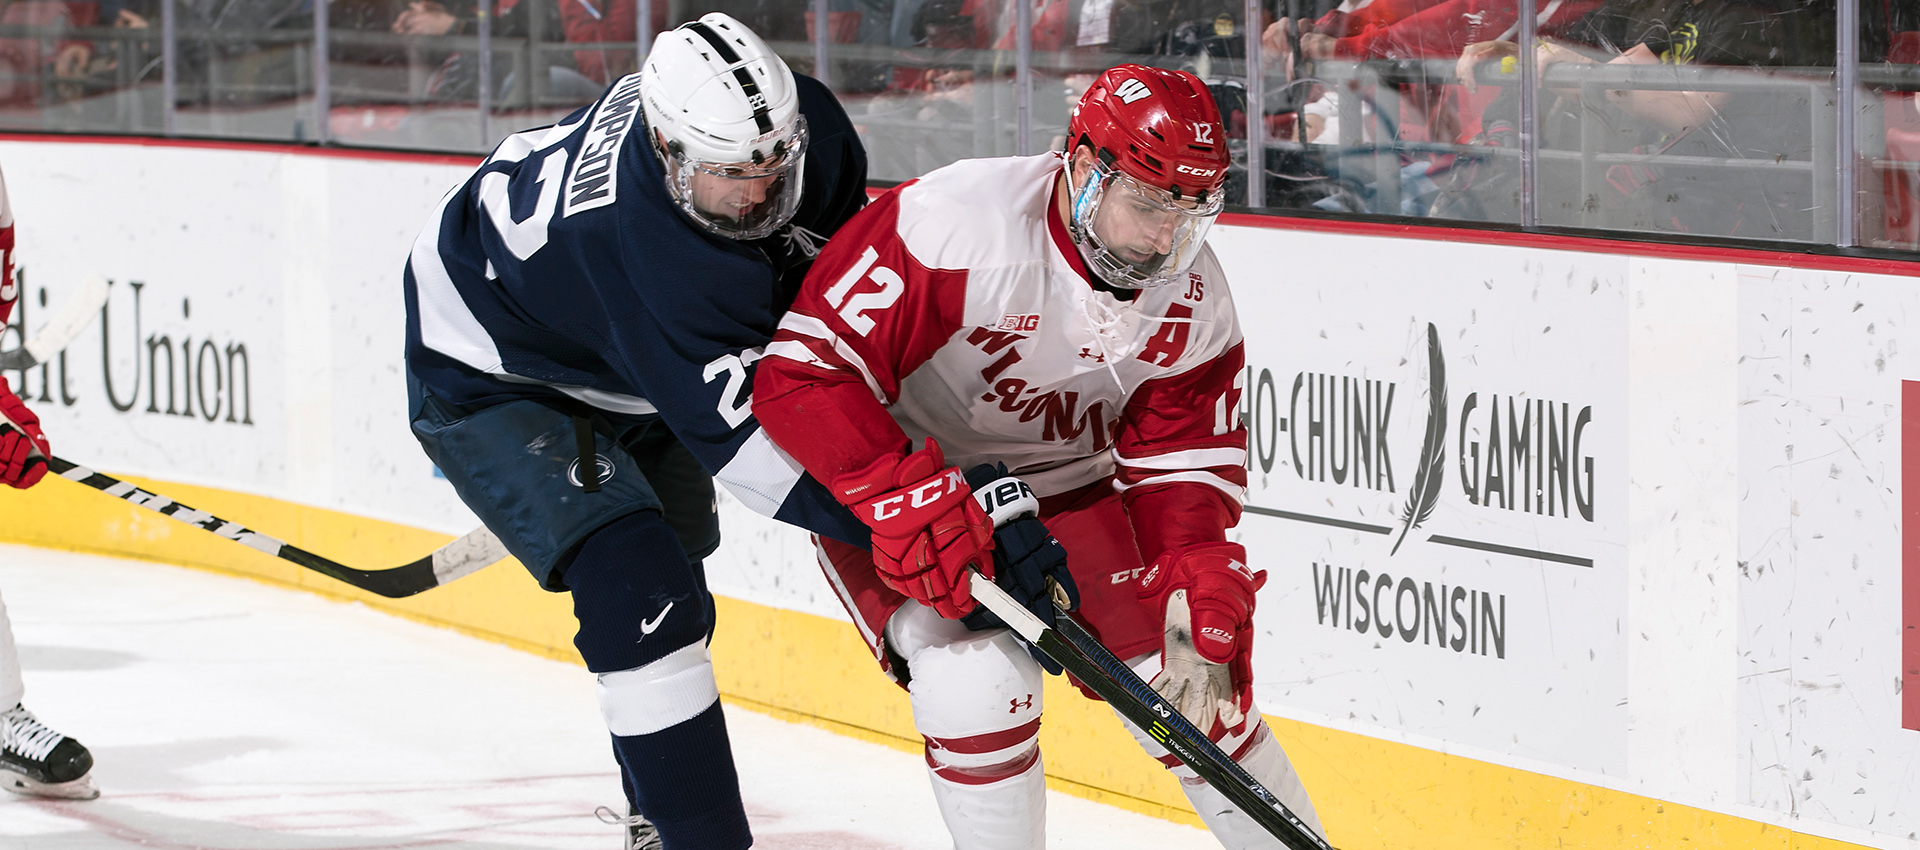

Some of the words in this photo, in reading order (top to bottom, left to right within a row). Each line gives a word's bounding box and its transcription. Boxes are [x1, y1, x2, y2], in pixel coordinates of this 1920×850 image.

[1113, 78, 1152, 105] W
[1193, 122, 1214, 145] 12
[1176, 164, 1217, 178] CCM
[823, 245, 905, 338] 12
[1184, 280, 1205, 302] JS
[102, 279, 254, 425] Union
[1136, 302, 1193, 368] A
[1459, 392, 1594, 522] GAMING
[871, 468, 968, 521] CCM
[1201, 626, 1234, 640] CCM
[1312, 562, 1505, 659] WISCONSIN
